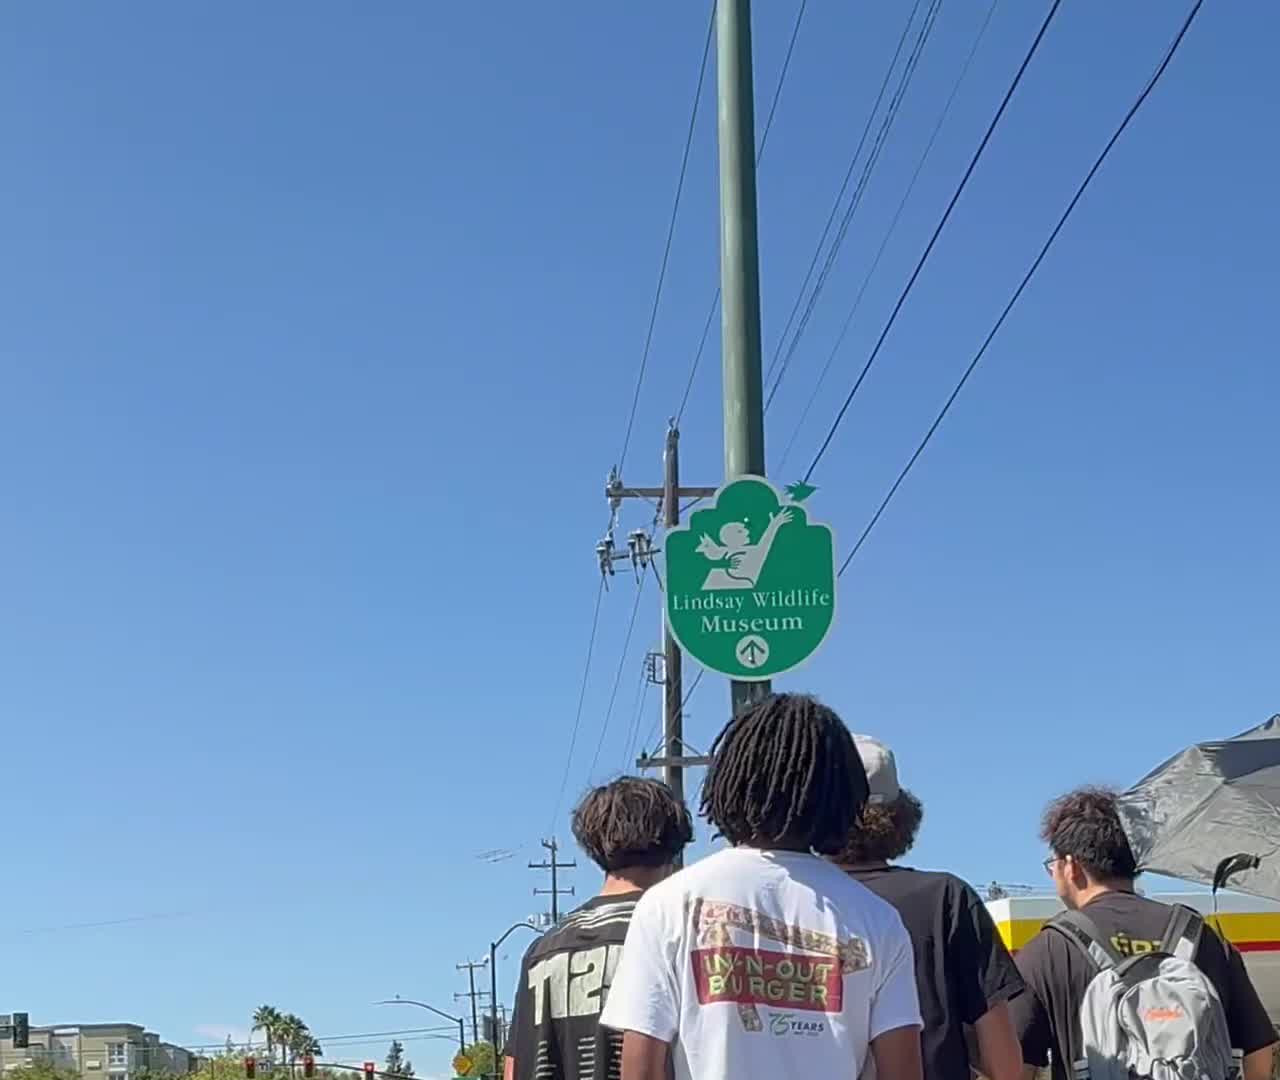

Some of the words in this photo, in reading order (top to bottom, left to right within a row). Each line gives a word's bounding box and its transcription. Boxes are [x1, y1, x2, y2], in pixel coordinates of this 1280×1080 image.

[673, 593, 744, 612] Lindsay
[752, 590, 830, 608] Wildlife
[701, 615, 803, 633] Museum
[704, 952, 834, 985] IN-N-OUT
[708, 975, 829, 1007] BURGER
[791, 1021, 825, 1033] YEARS
